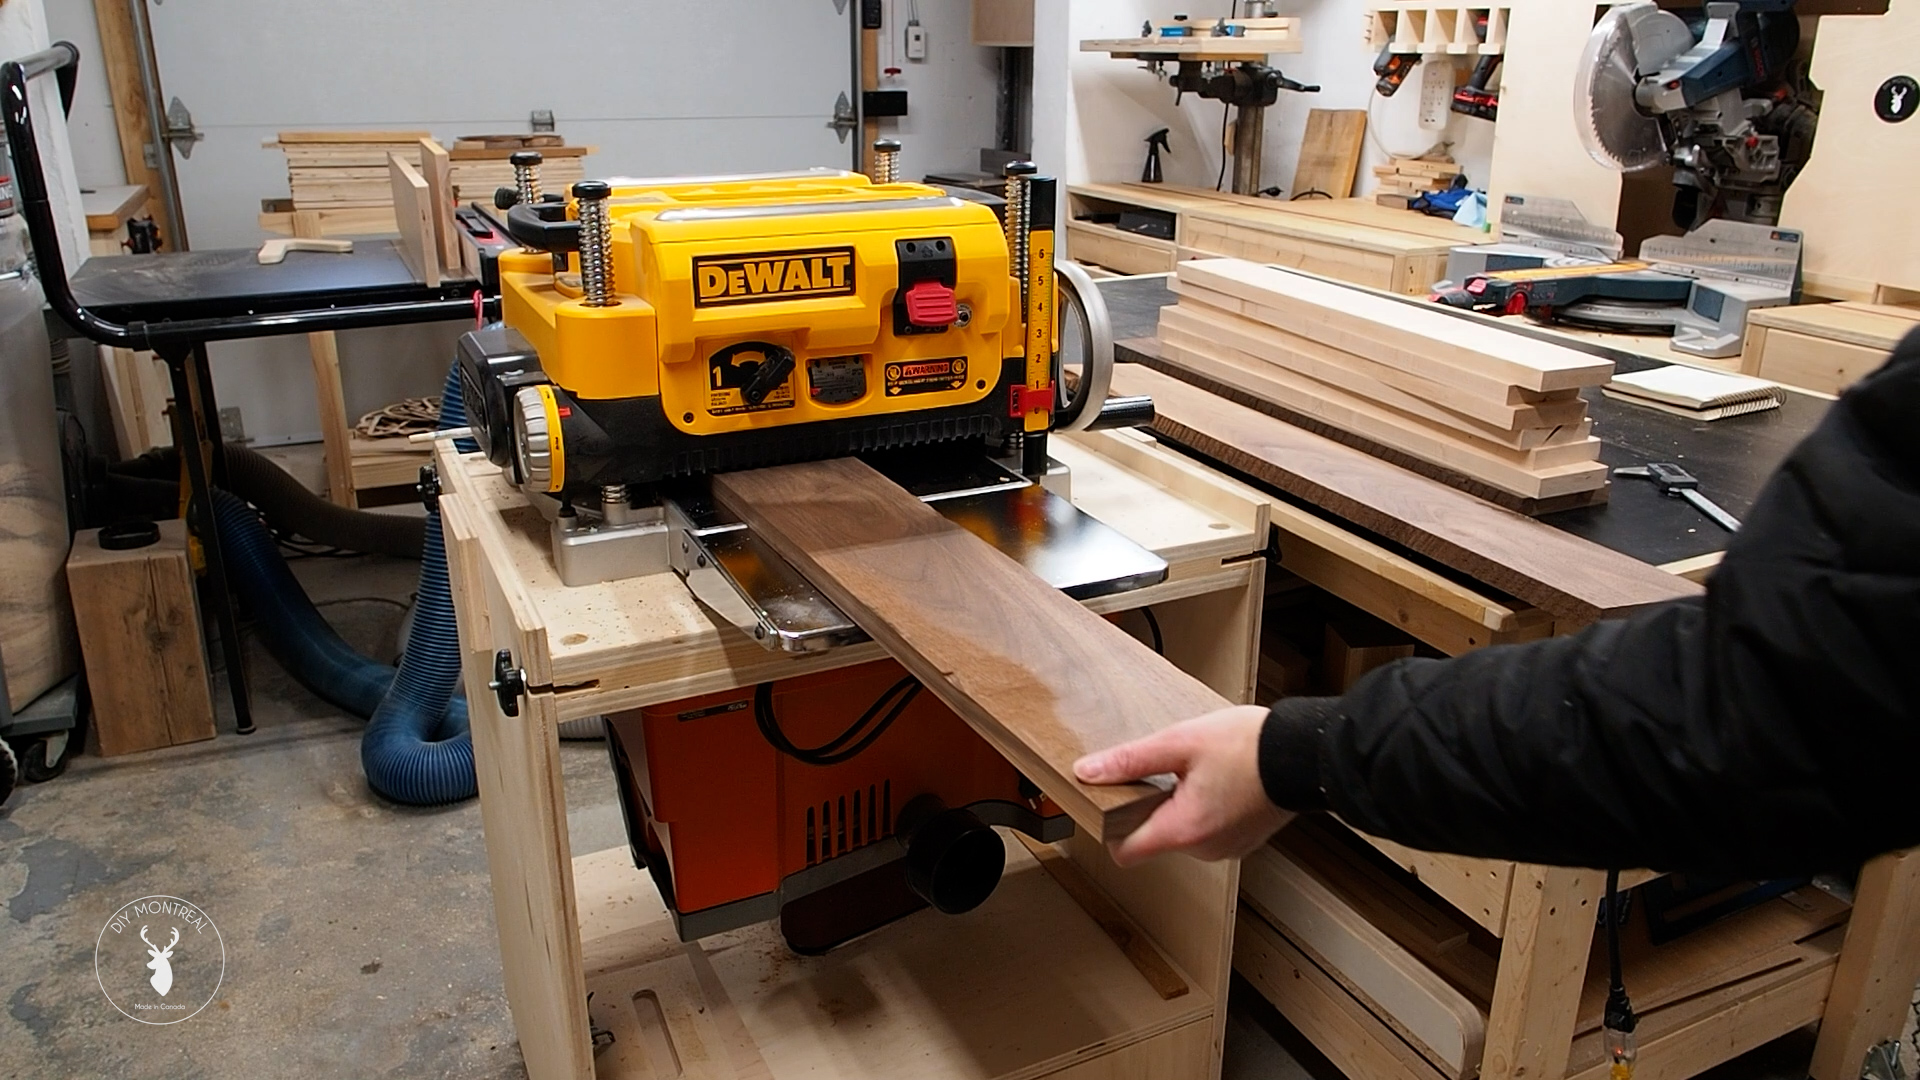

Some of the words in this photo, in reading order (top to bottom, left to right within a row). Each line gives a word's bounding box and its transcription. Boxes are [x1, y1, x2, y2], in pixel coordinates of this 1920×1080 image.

[1038, 249, 1045, 259] 6
[1037, 275, 1044, 286] 5
[1037, 302, 1043, 312] 4
[1036, 329, 1042, 338] 3
[1035, 354, 1041, 363] 2
[911, 364, 948, 375] WARNING
[712, 365, 722, 387] 1
